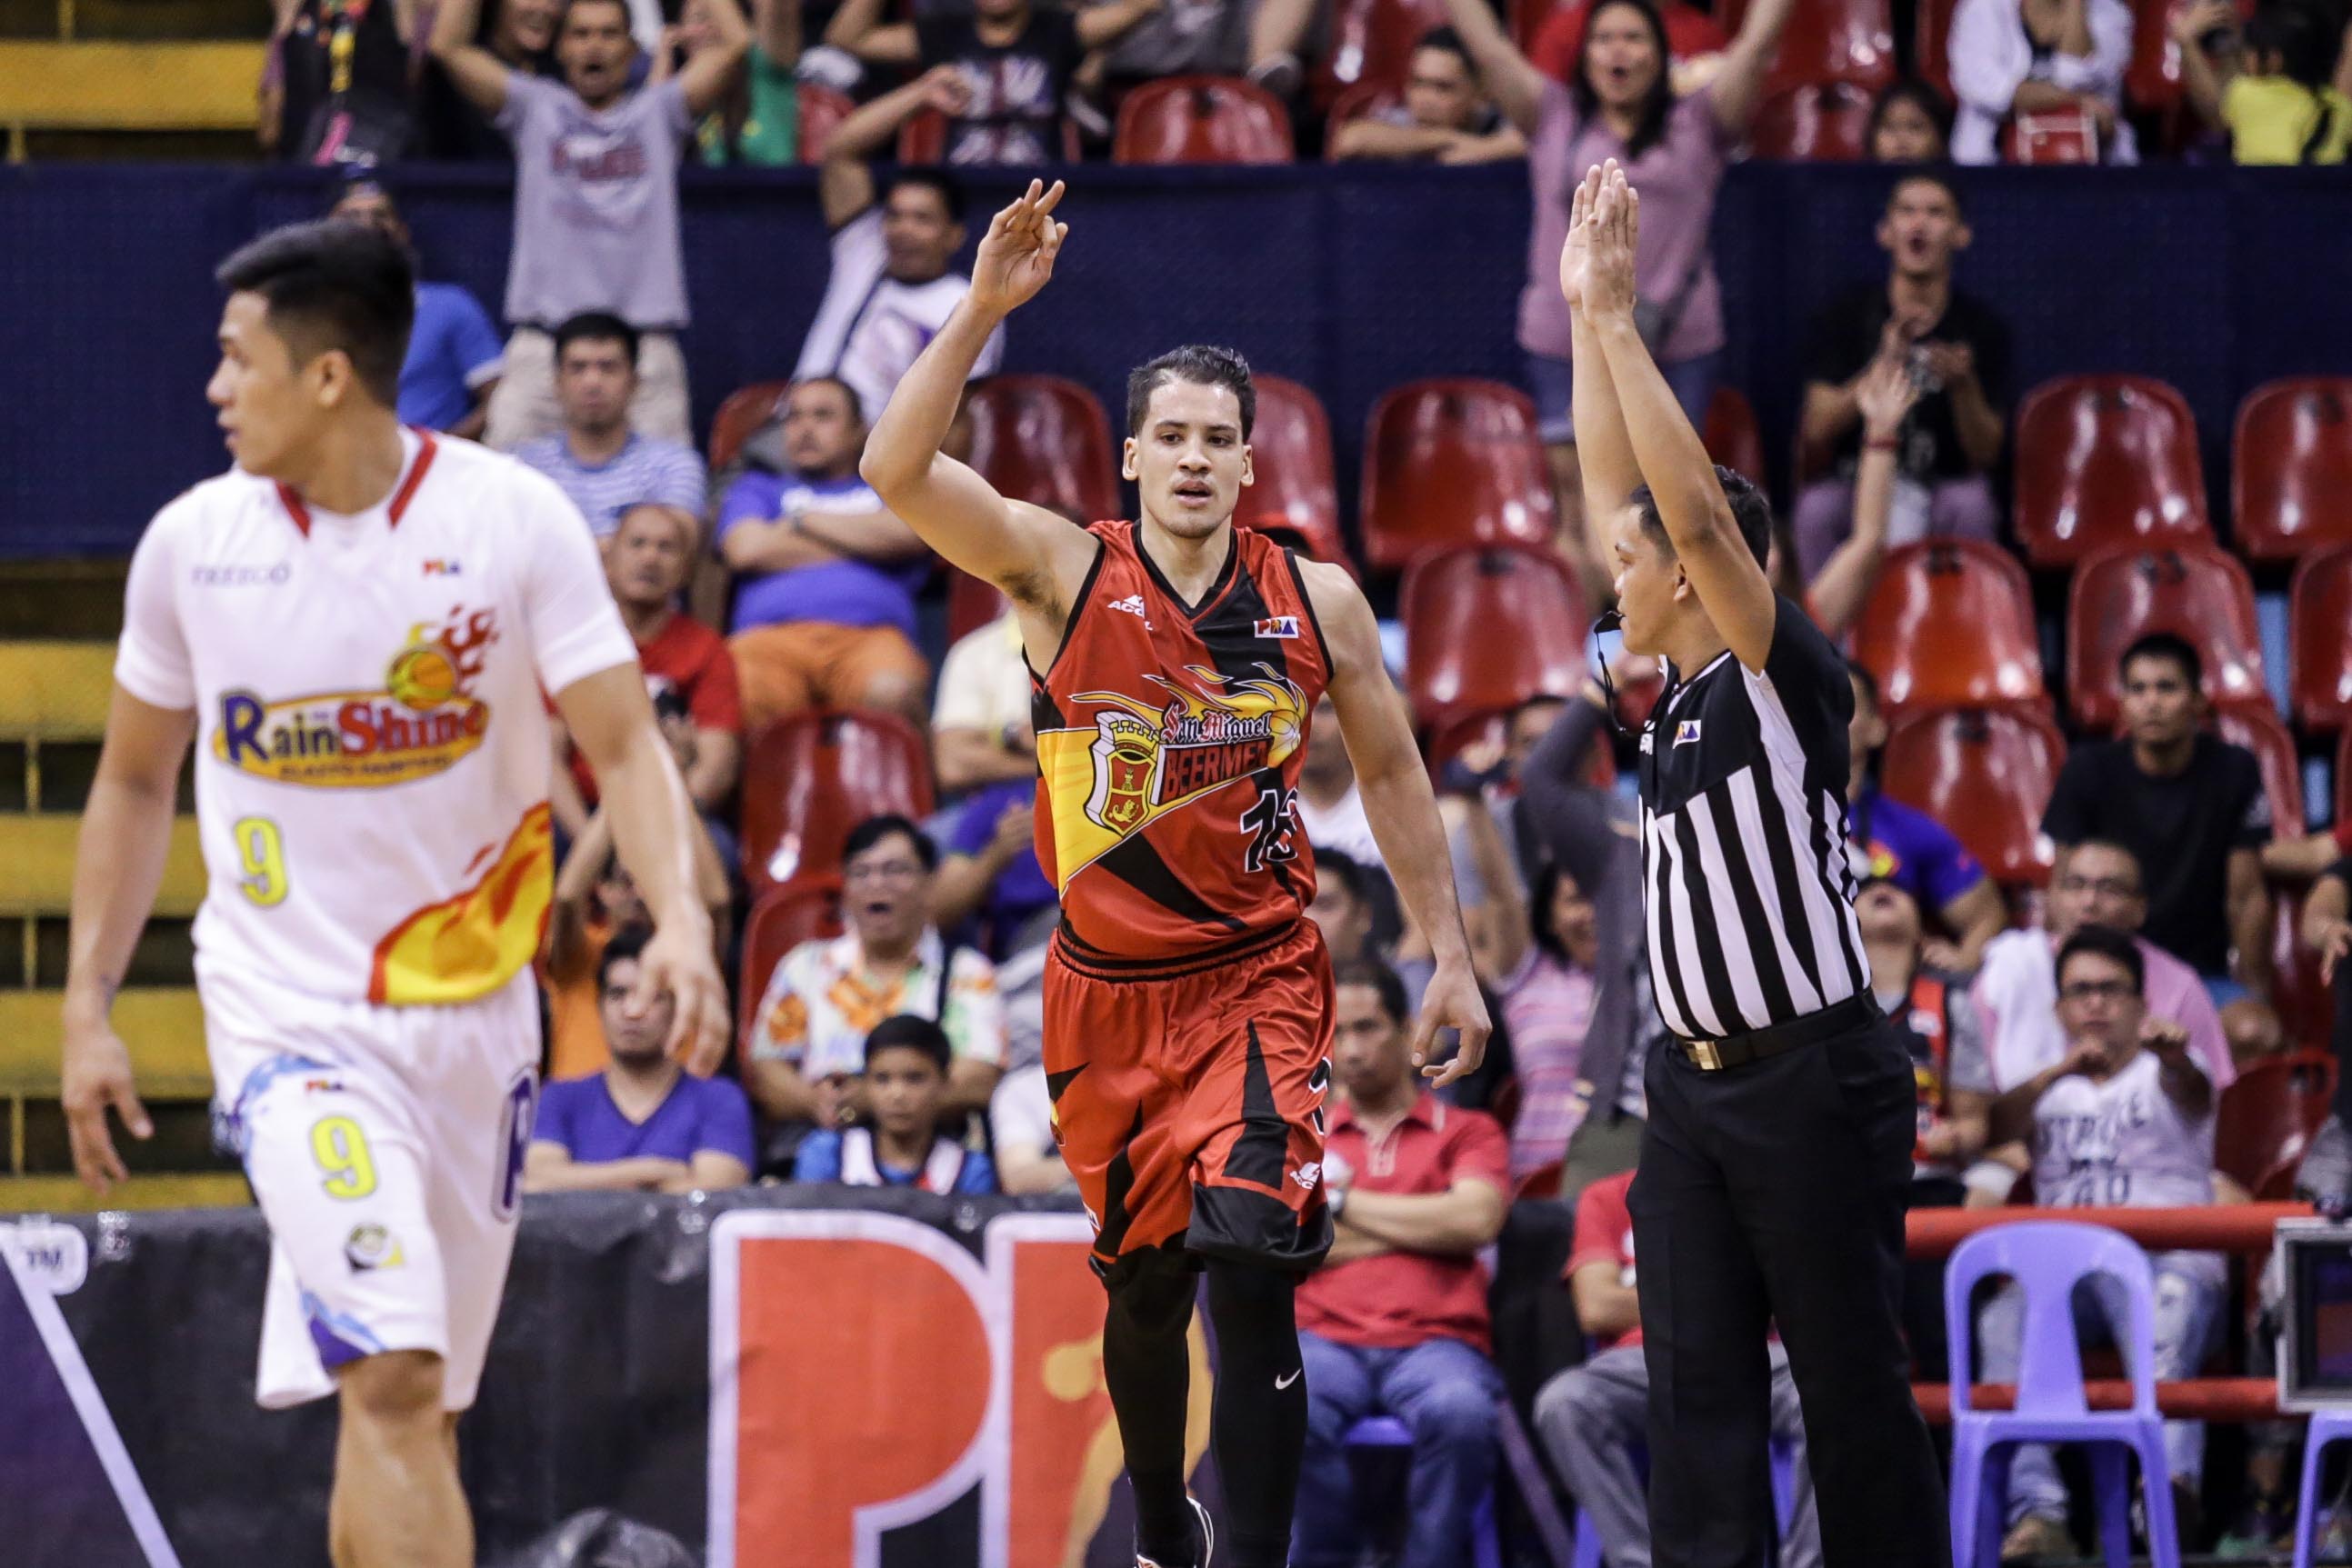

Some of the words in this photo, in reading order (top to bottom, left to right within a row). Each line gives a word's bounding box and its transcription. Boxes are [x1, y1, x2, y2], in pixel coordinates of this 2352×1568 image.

[1256, 618, 1297, 635] PBA
[223, 694, 336, 763] Rain
[337, 698, 488, 756] Shine
[1161, 703, 1200, 743] San
[1200, 710, 1271, 744] Miguel
[233, 815, 290, 908] 9
[310, 1114, 378, 1200] 9
